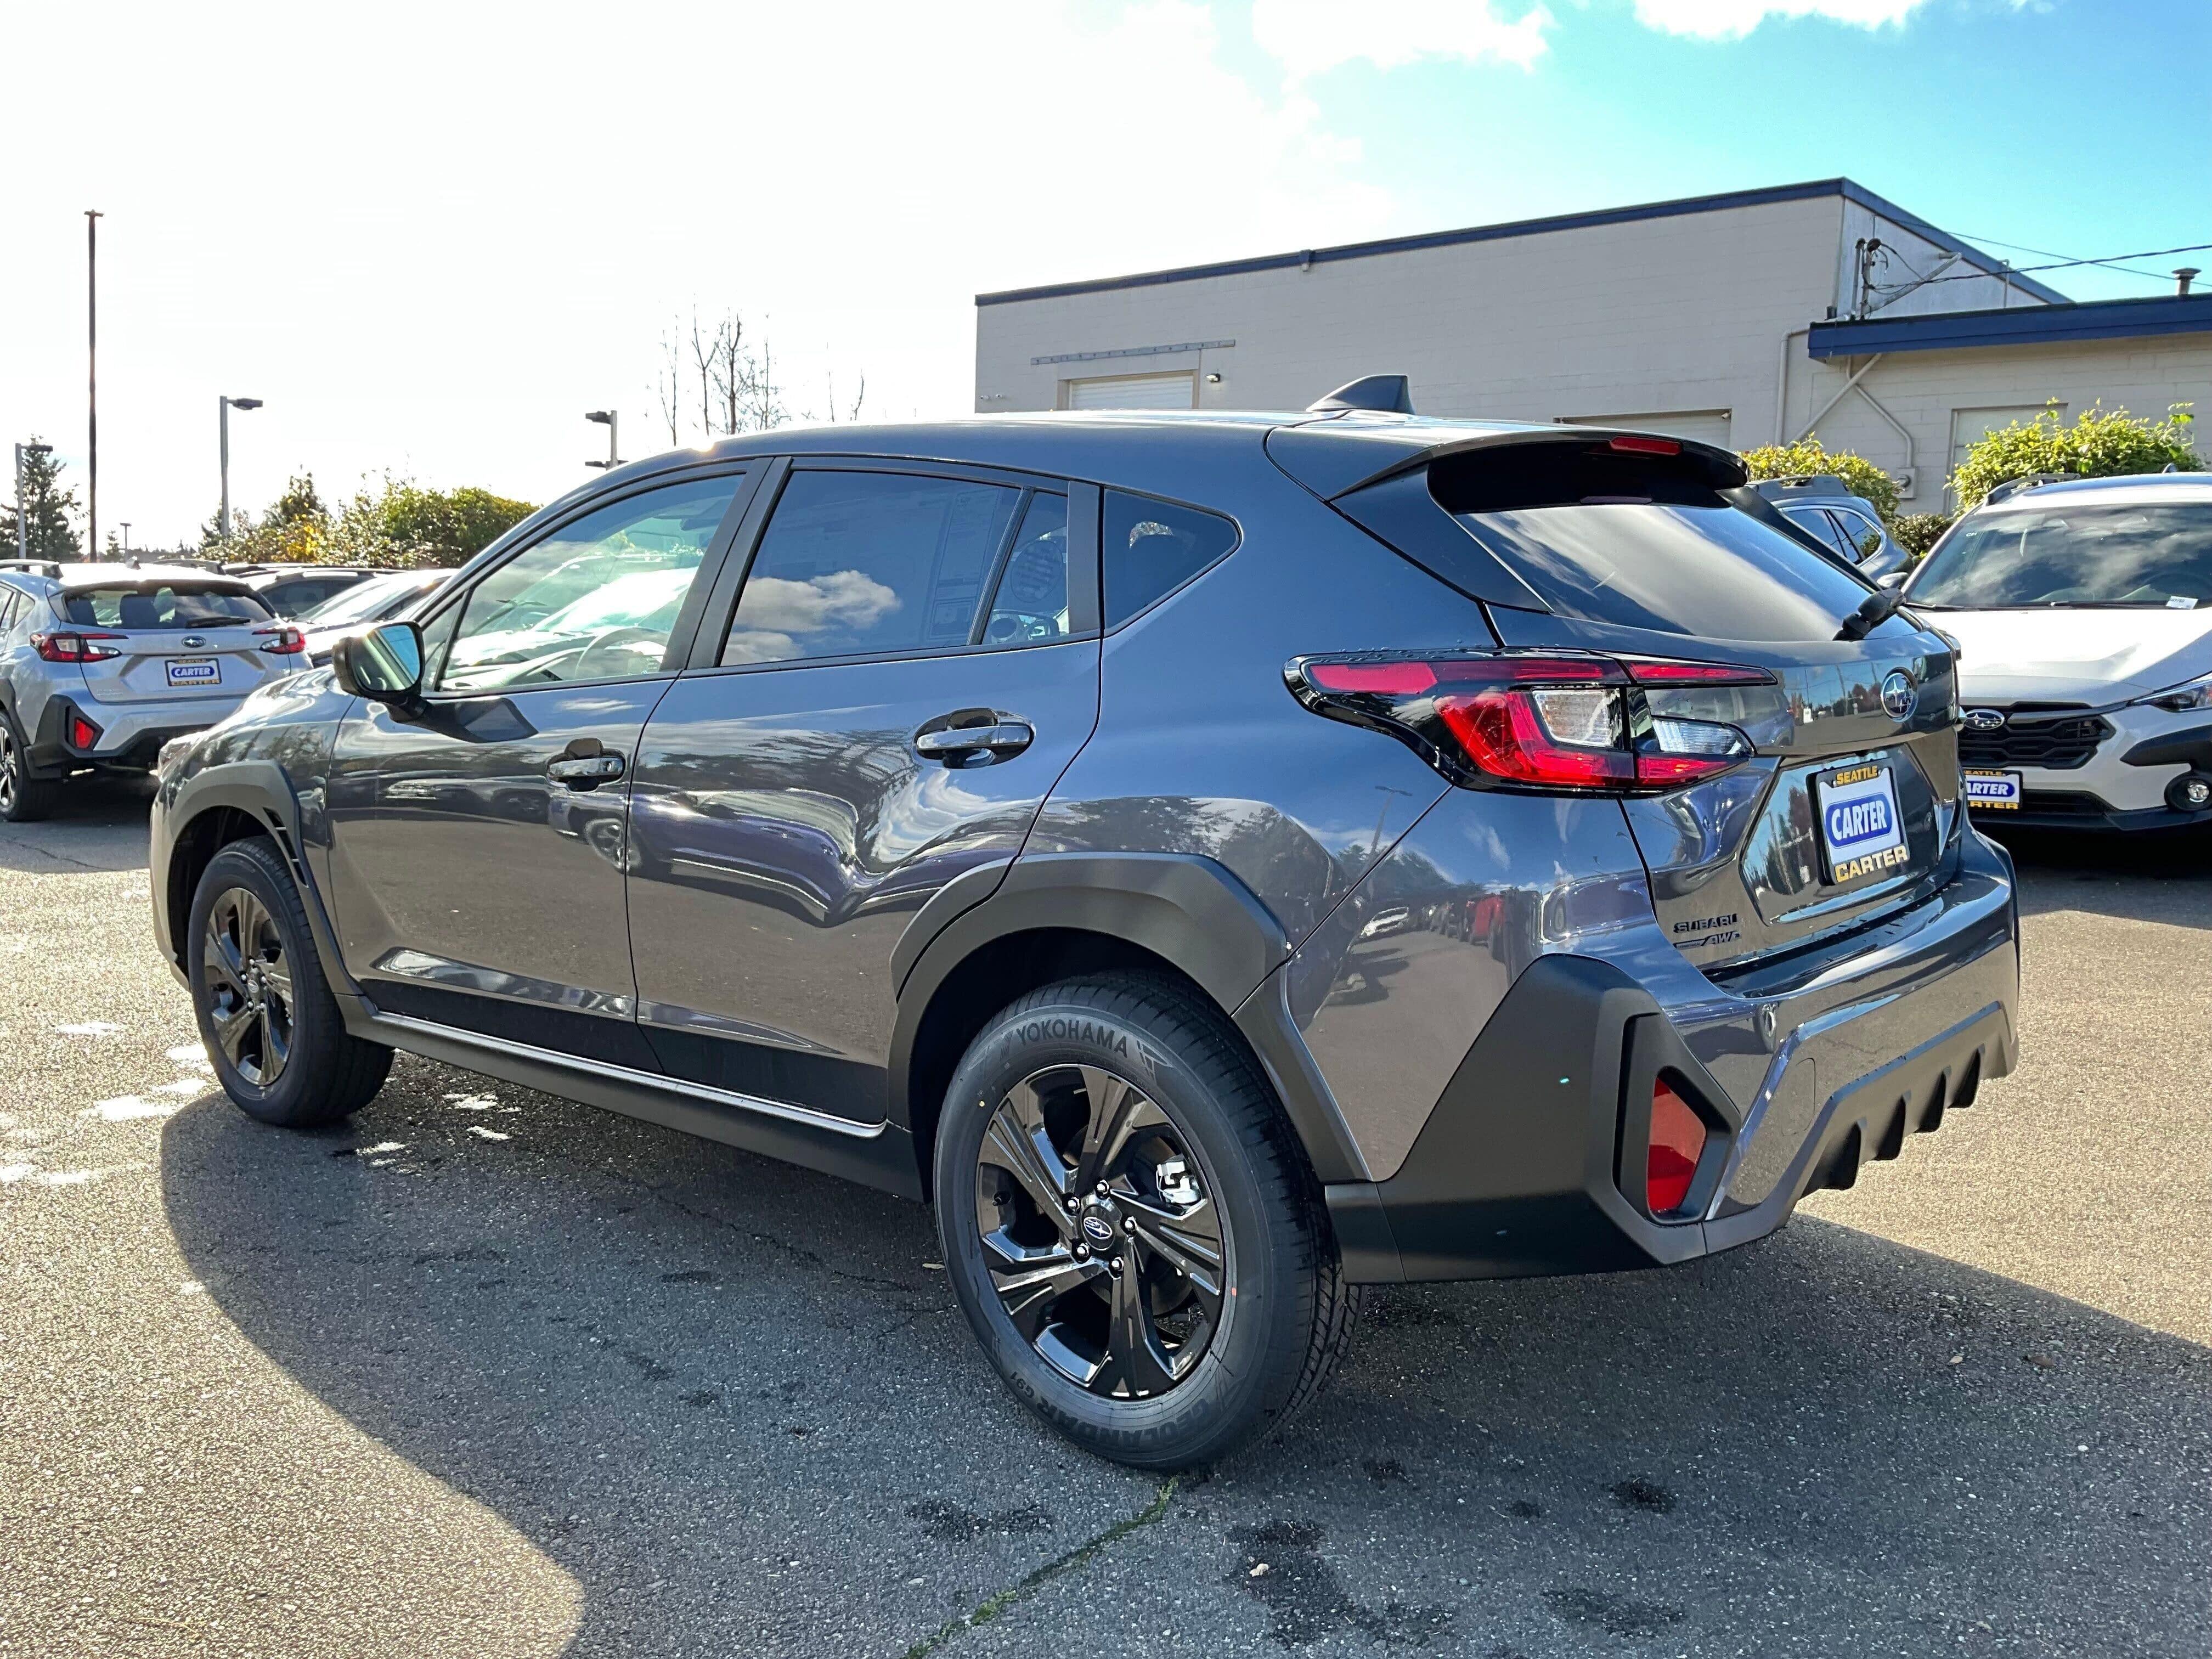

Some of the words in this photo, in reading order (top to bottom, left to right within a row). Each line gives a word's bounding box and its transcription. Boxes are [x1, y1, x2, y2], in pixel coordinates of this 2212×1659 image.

[174, 667, 211, 676] CARTER
[1836, 765, 1878, 786] SEATTLE
[1967, 782, 2008, 795] RTER
[1970, 801, 2018, 809] RTER
[1831, 799, 1887, 841] CARTER
[1834, 845, 1909, 883] CARTER
[1673, 913, 1739, 933] SUBARU
[1702, 930, 1742, 946] AWD
[1016, 1018, 1127, 1058] YOKOHAMA
[1009, 1371, 1034, 1398] G91
